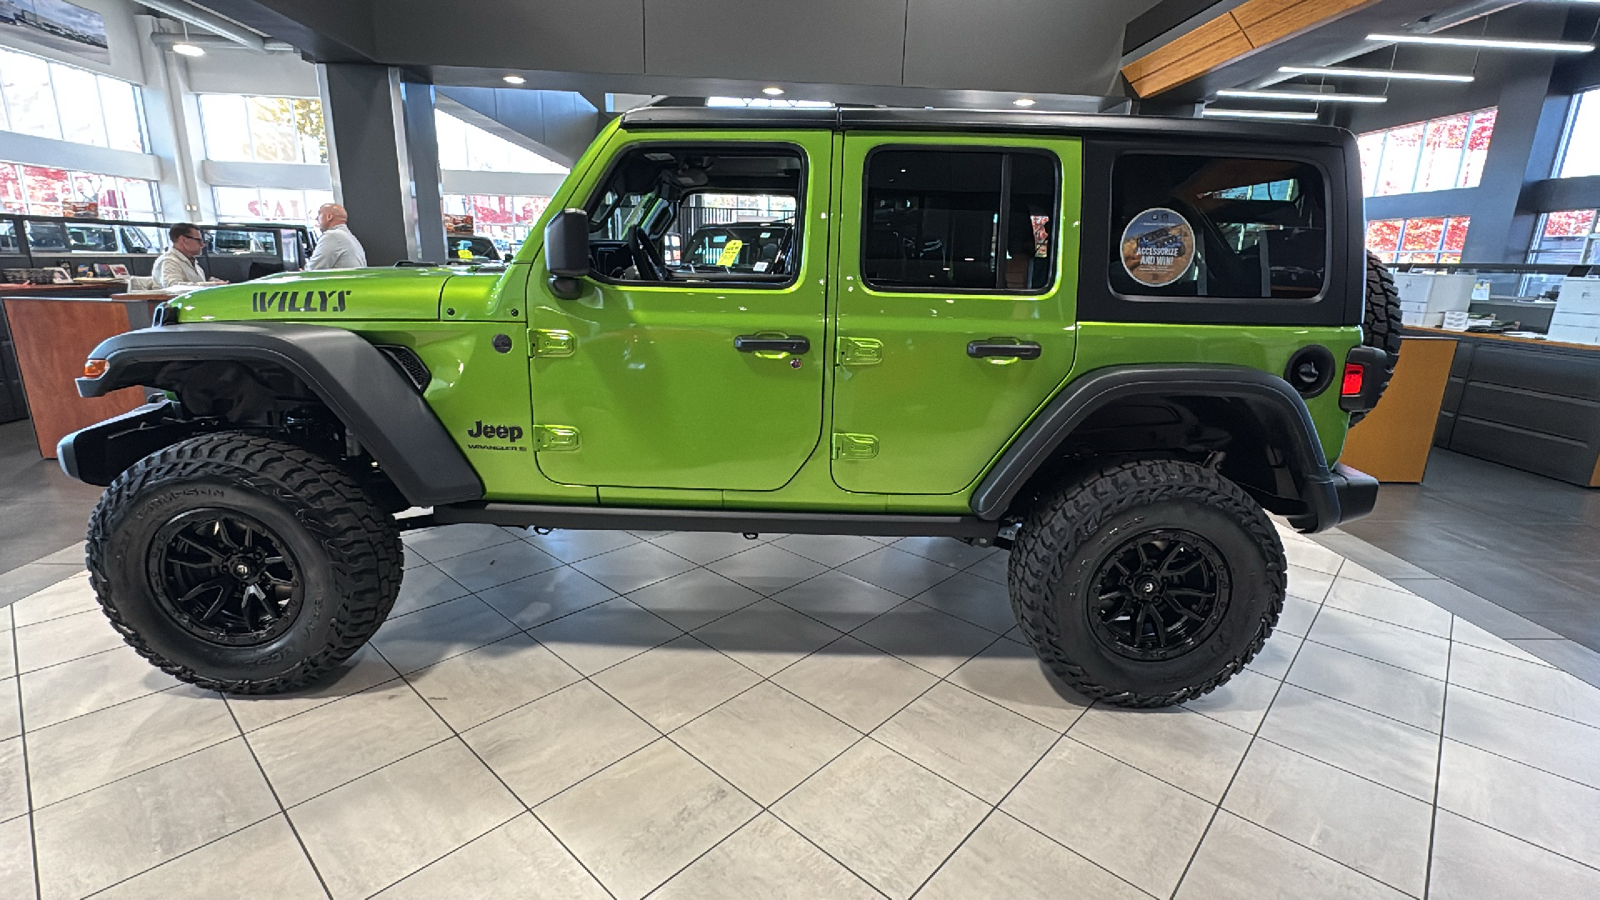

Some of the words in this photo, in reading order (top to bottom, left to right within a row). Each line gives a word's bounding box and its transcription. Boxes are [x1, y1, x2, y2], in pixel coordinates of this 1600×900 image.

[1136, 247, 1179, 257] ACCESSORIZE
[1140, 256, 1155, 265] AND
[252, 290, 352, 312] WILLYS
[467, 420, 523, 443] Jeep
